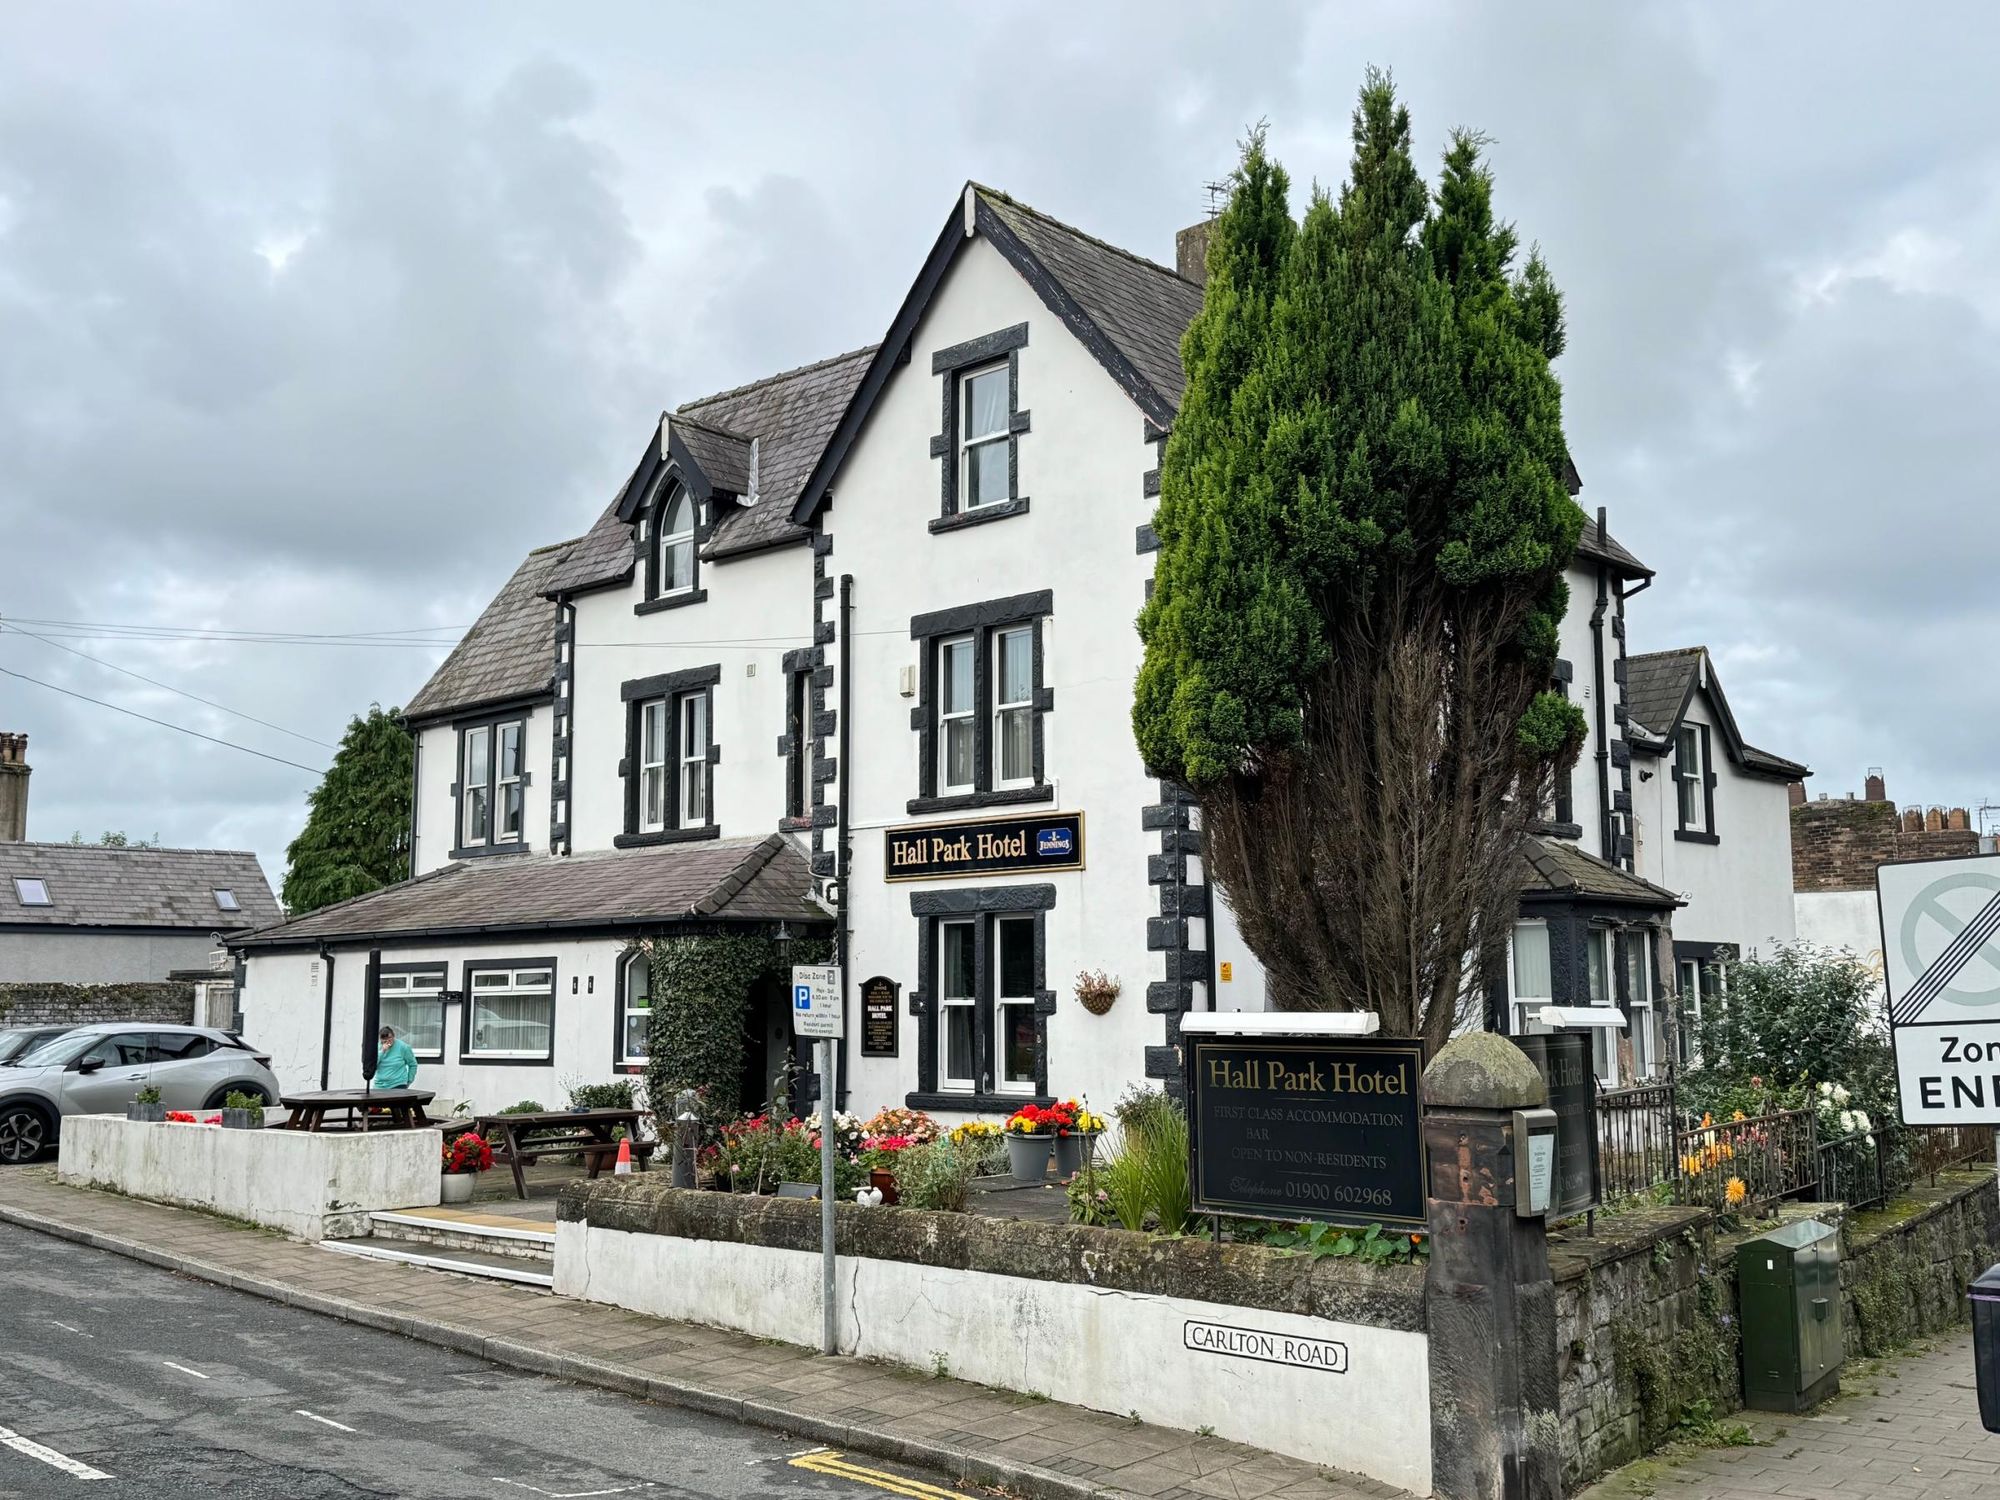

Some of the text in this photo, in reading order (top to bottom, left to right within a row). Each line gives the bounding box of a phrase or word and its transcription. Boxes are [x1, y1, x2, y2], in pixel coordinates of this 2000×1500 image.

[892, 830, 1027, 866] Hall Park Hotel
[1039, 839, 1070, 851] JENNINGS
[799, 972, 811, 980] Disc
[812, 972, 826, 980] Zone
[798, 988, 808, 1008] P
[1208, 1059, 1408, 1096] Hall Park Hotel
[1559, 1057, 1583, 1088] Hotel
[1213, 1105, 1404, 1127] FIRST CLASS ACCOMMODATION
[1246, 1127, 1270, 1141] BAR
[1231, 1146, 1387, 1170] OPEN TO NON-RESIDENTS
[1285, 1181, 1329, 1200] 01900
[1334, 1185, 1393, 1207] 602968
[1192, 1327, 1338, 1366] CARLTON ROAD
